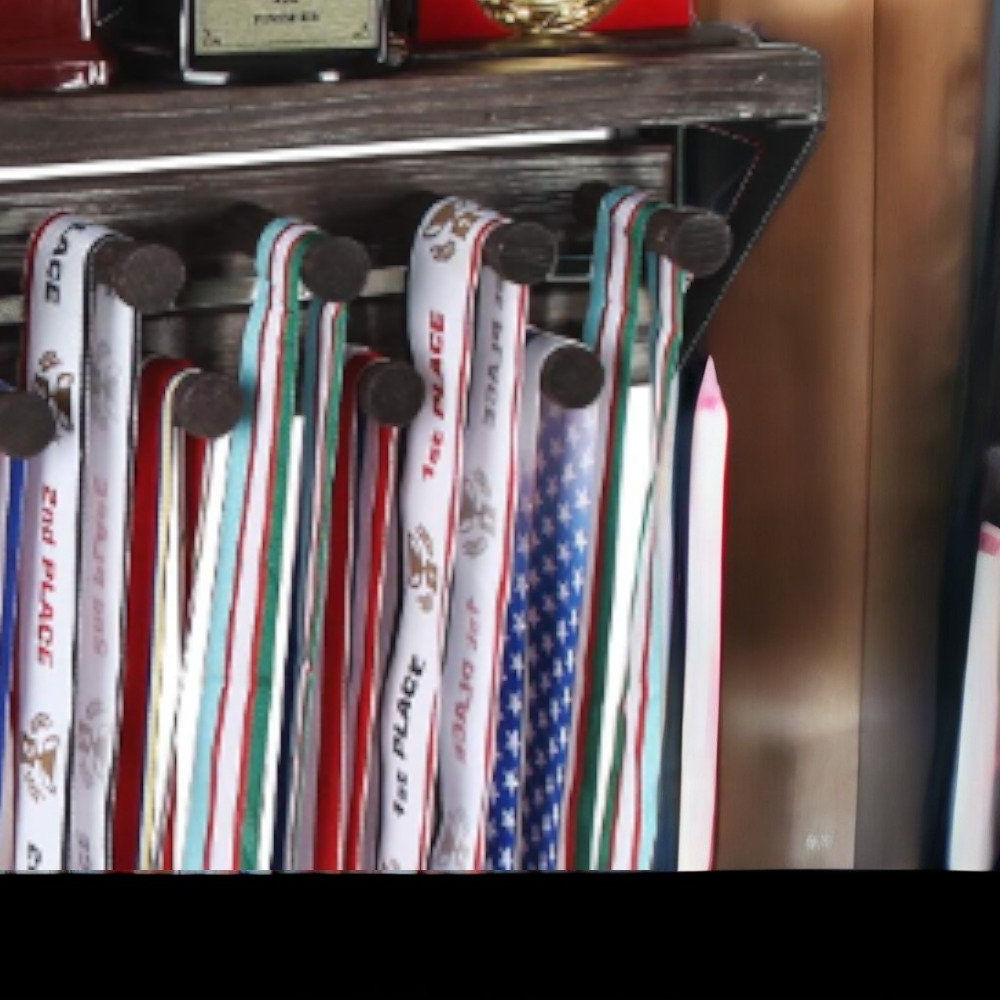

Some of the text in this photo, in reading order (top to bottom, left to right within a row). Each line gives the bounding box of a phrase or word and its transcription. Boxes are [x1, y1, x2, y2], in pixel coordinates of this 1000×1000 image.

[45, 222, 86, 303] LACE
[422, 310, 444, 481] 1st PLACE
[38, 485, 57, 667] 2nd PLACE
[392, 653, 426, 817] 1st PLACE
